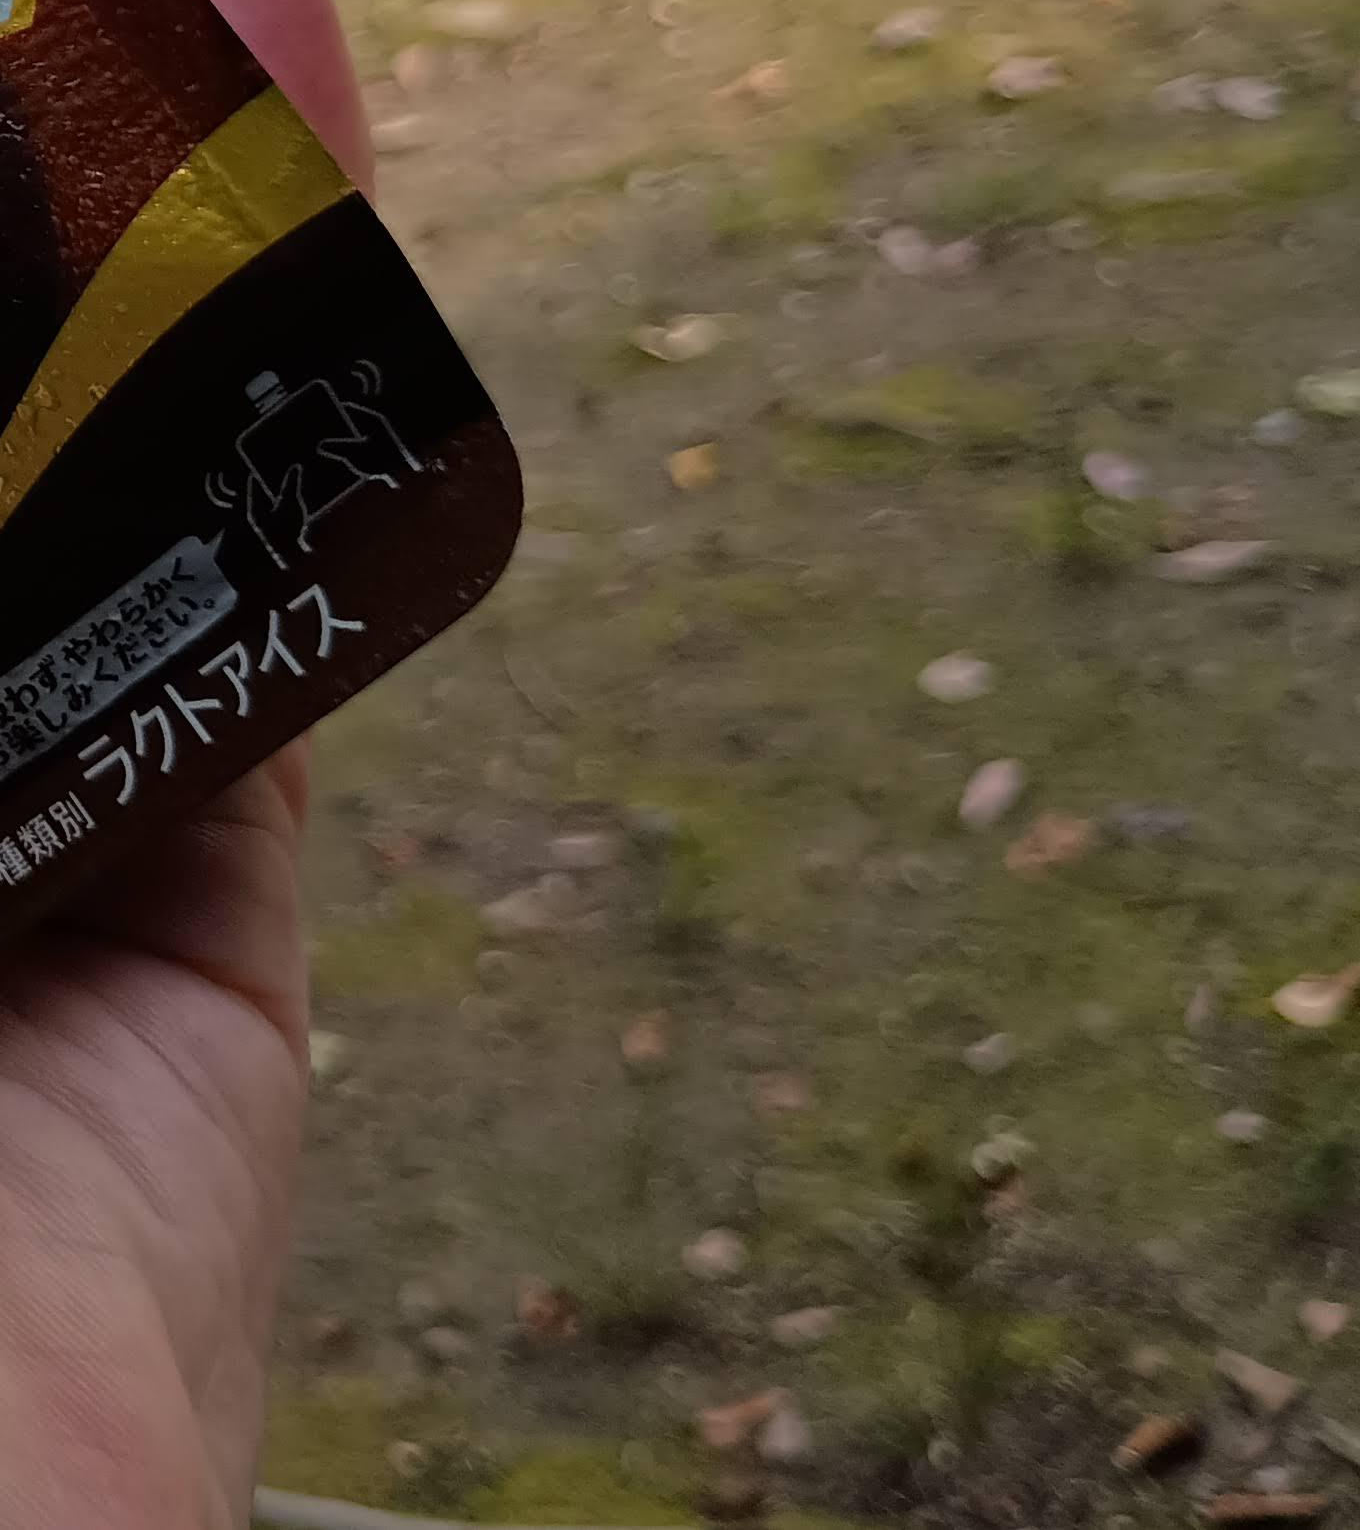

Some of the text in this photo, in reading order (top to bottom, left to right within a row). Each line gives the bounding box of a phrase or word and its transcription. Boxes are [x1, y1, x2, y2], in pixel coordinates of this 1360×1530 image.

[78, 583, 365, 807] ラクトアイス
